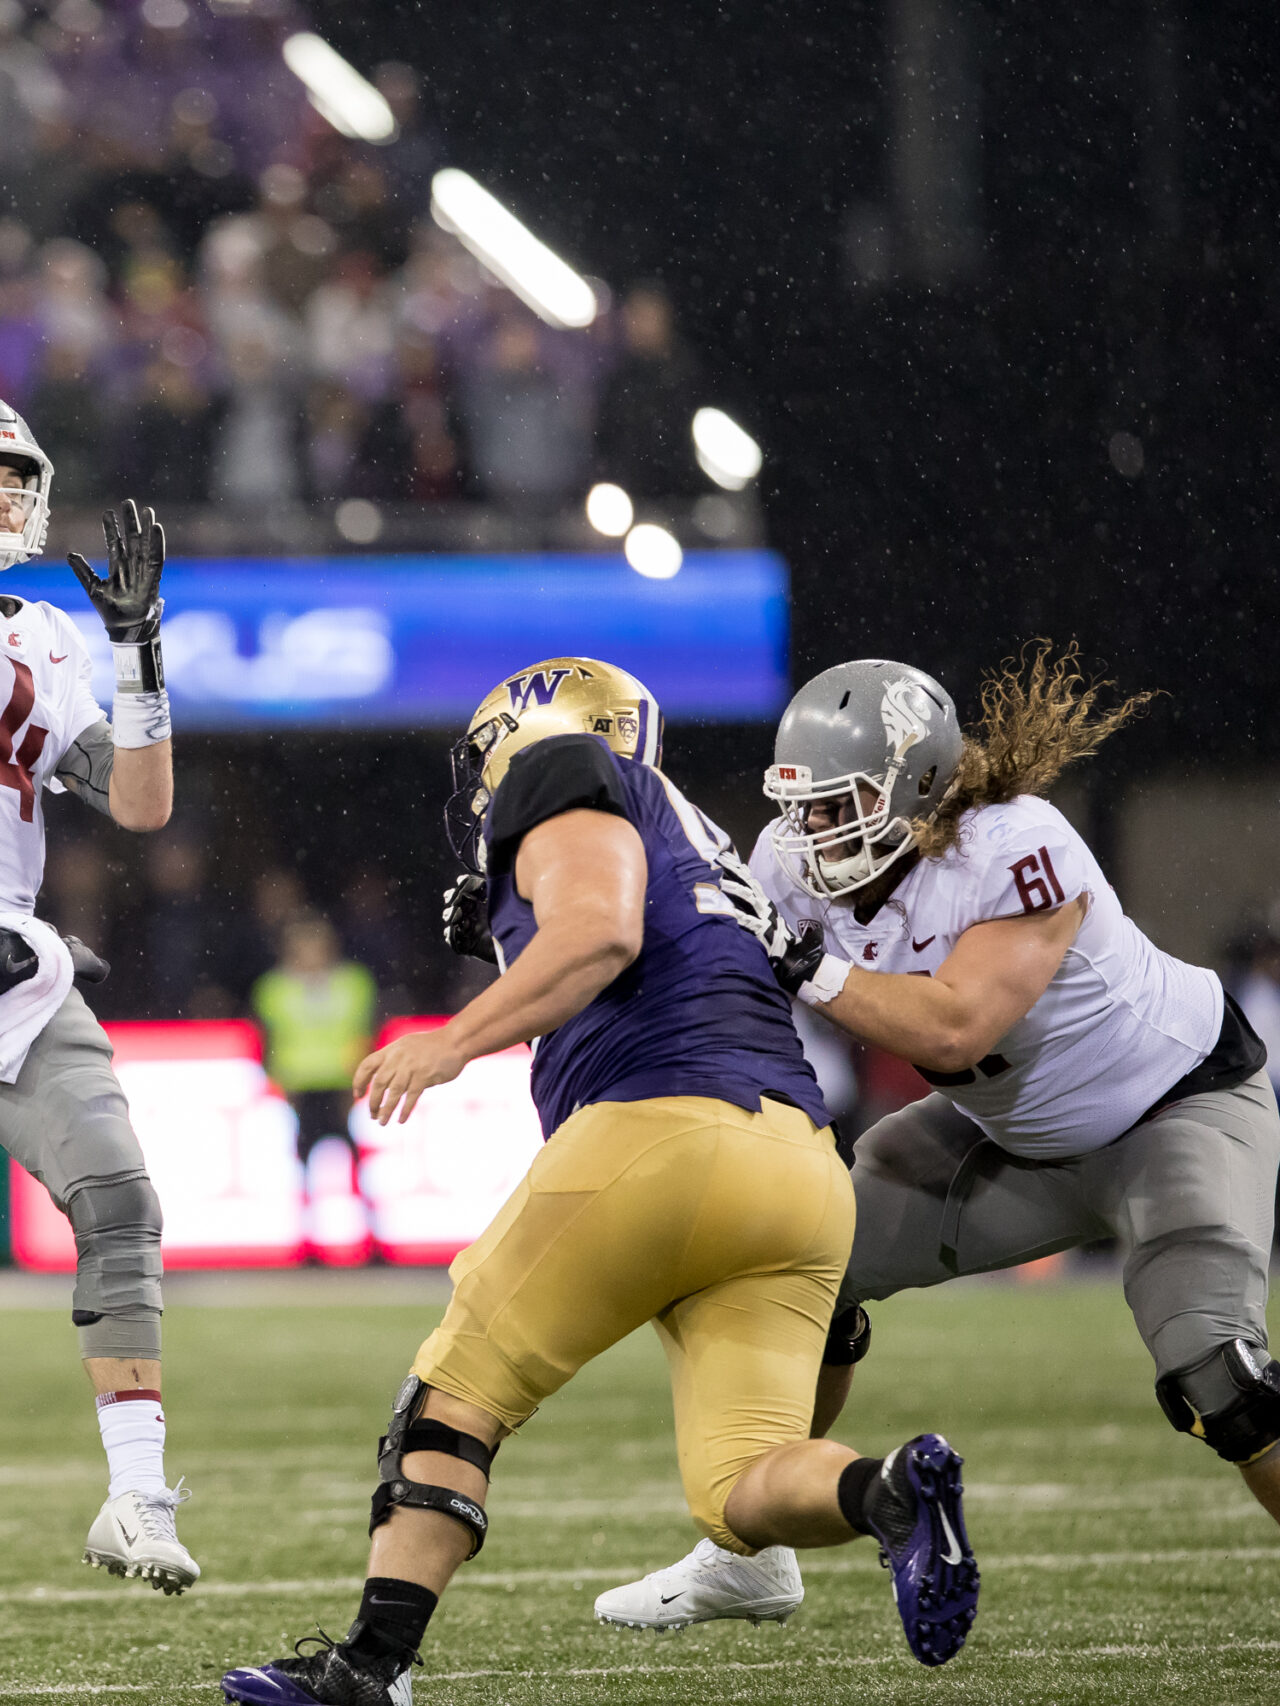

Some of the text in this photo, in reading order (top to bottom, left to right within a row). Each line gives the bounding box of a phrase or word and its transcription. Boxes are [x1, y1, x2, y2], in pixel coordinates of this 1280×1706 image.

[502, 668, 573, 711] W
[592, 717, 613, 733] AT
[1006, 845, 1066, 914] 61
